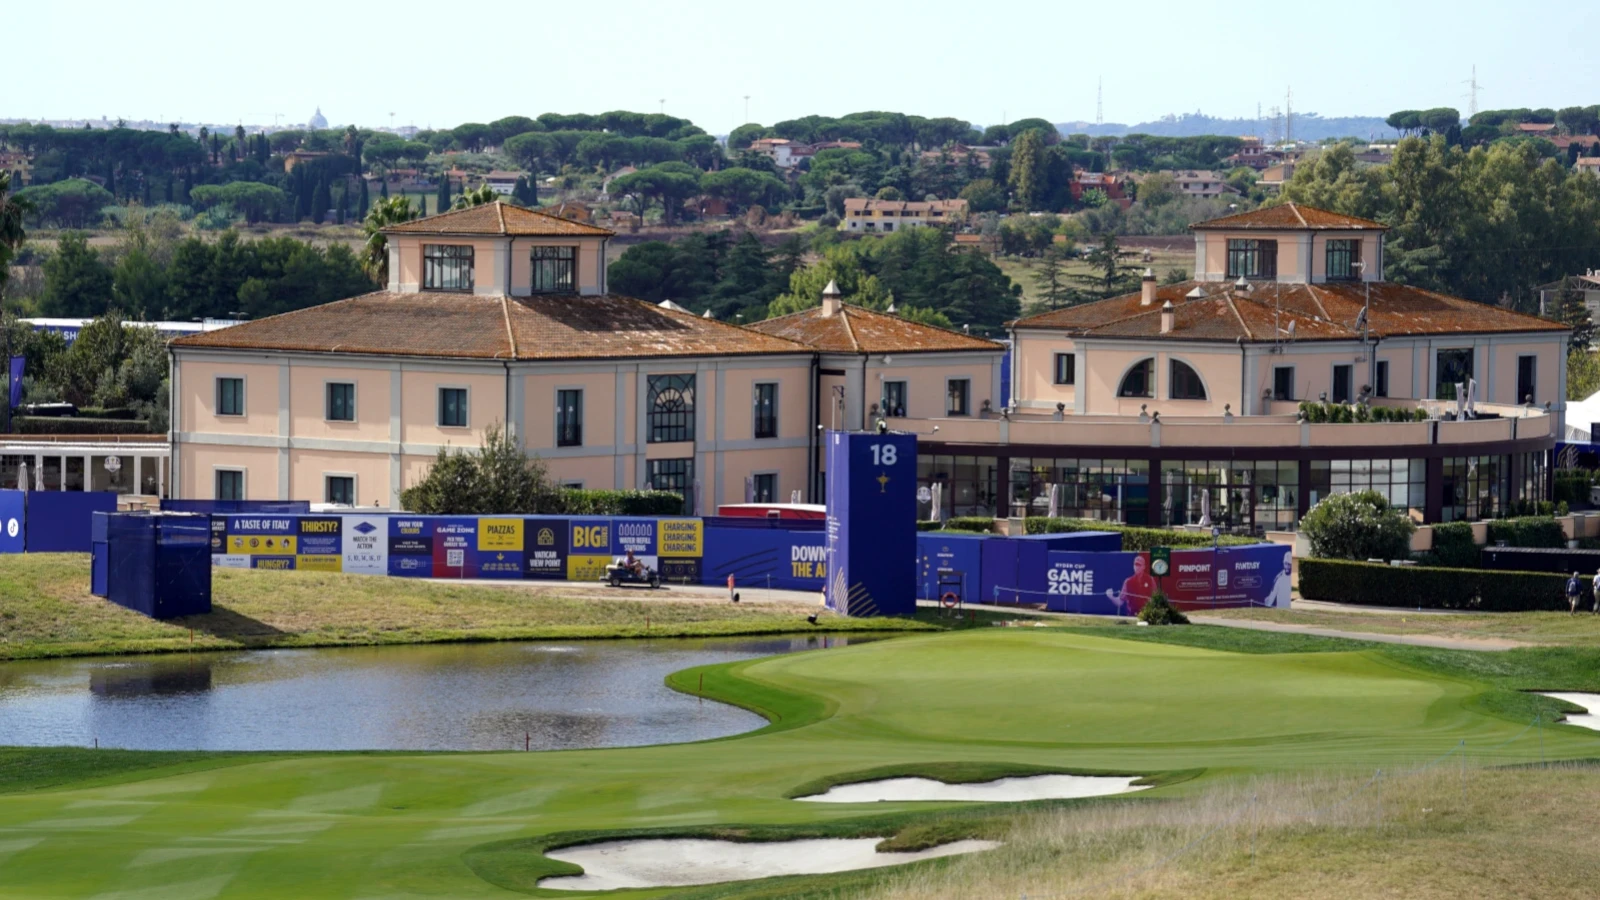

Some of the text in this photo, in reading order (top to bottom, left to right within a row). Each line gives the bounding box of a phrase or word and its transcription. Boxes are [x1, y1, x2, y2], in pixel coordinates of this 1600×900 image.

[870, 443, 897, 466] 18
[234, 519, 240, 530] A
[241, 519, 260, 530] TASTE
[262, 519, 271, 530] OF
[272, 519, 290, 530] ITALY
[301, 521, 338, 532] THIRSTY?
[487, 525, 515, 534] PIAZZAS
[663, 523, 697, 531] CHARGING
[573, 526, 602, 547] BIG
[663, 532, 696, 541] CHARGING
[663, 543, 696, 552] CHARGING
[534, 551, 557, 559] VATICAN
[791, 545, 826, 562] DOWN
[257, 559, 290, 570] HUNGRY?
[529, 559, 561, 567] VIEW POINT
[1178, 564, 1211, 572] PINPOINT
[1235, 562, 1261, 570] FANTASY
[791, 562, 813, 577] THE
[1047, 569, 1093, 583] GAME
[1047, 581, 1093, 595] ZONE
